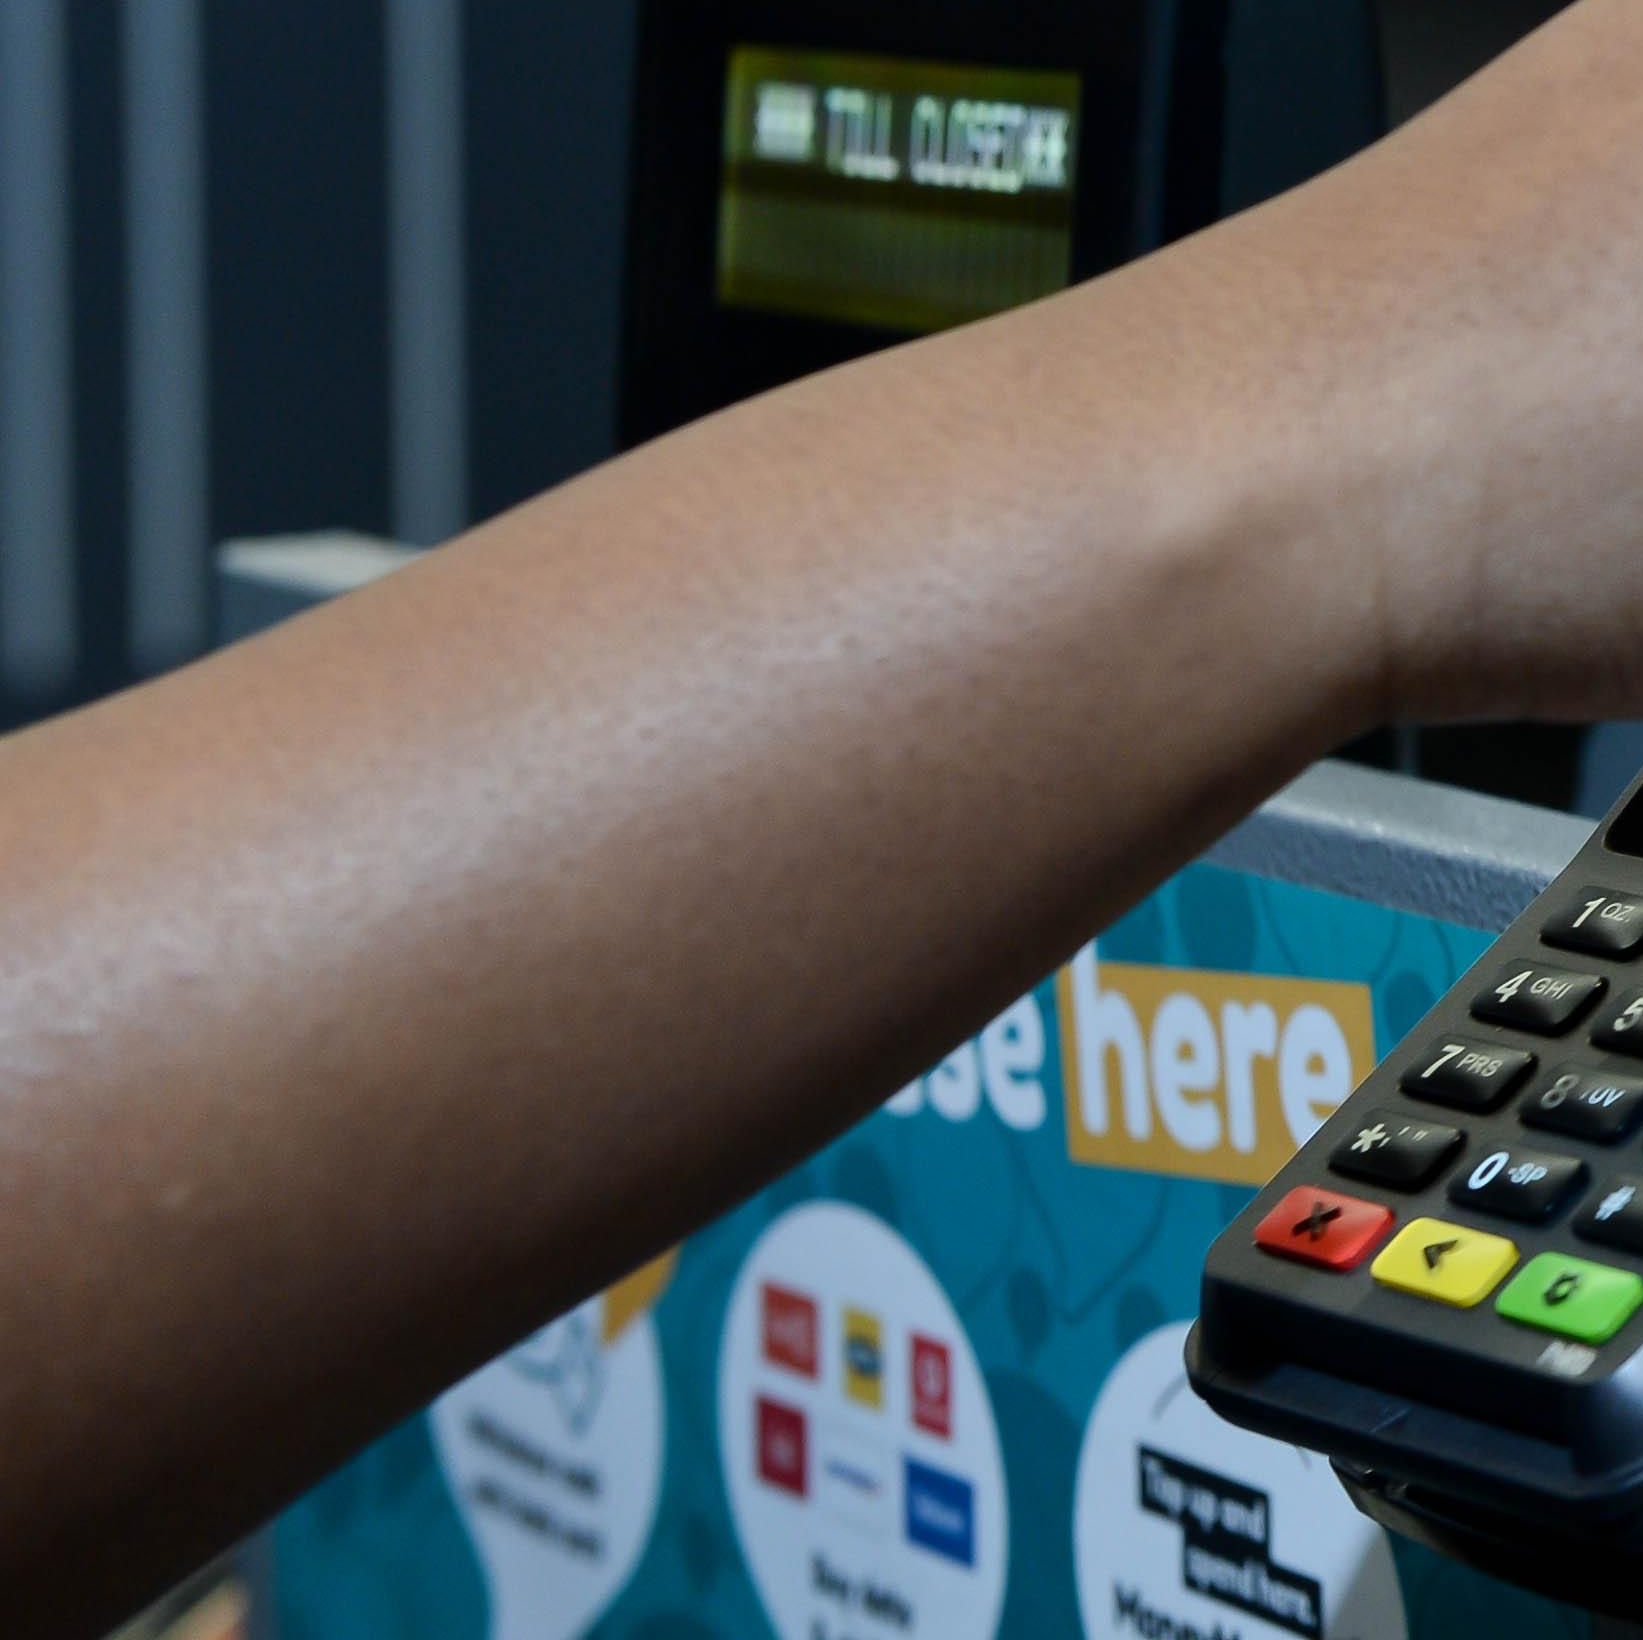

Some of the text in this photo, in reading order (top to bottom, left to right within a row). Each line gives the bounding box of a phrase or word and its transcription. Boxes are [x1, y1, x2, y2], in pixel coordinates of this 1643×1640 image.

[1572, 897, 1608, 929] 1
[1495, 970, 1574, 1004] 4 GHI
[1068, 938, 1352, 1158] here
[1421, 1043, 1467, 1079] 7
[1540, 1073, 1580, 1110] 8
[1467, 1151, 1511, 1190] 0
